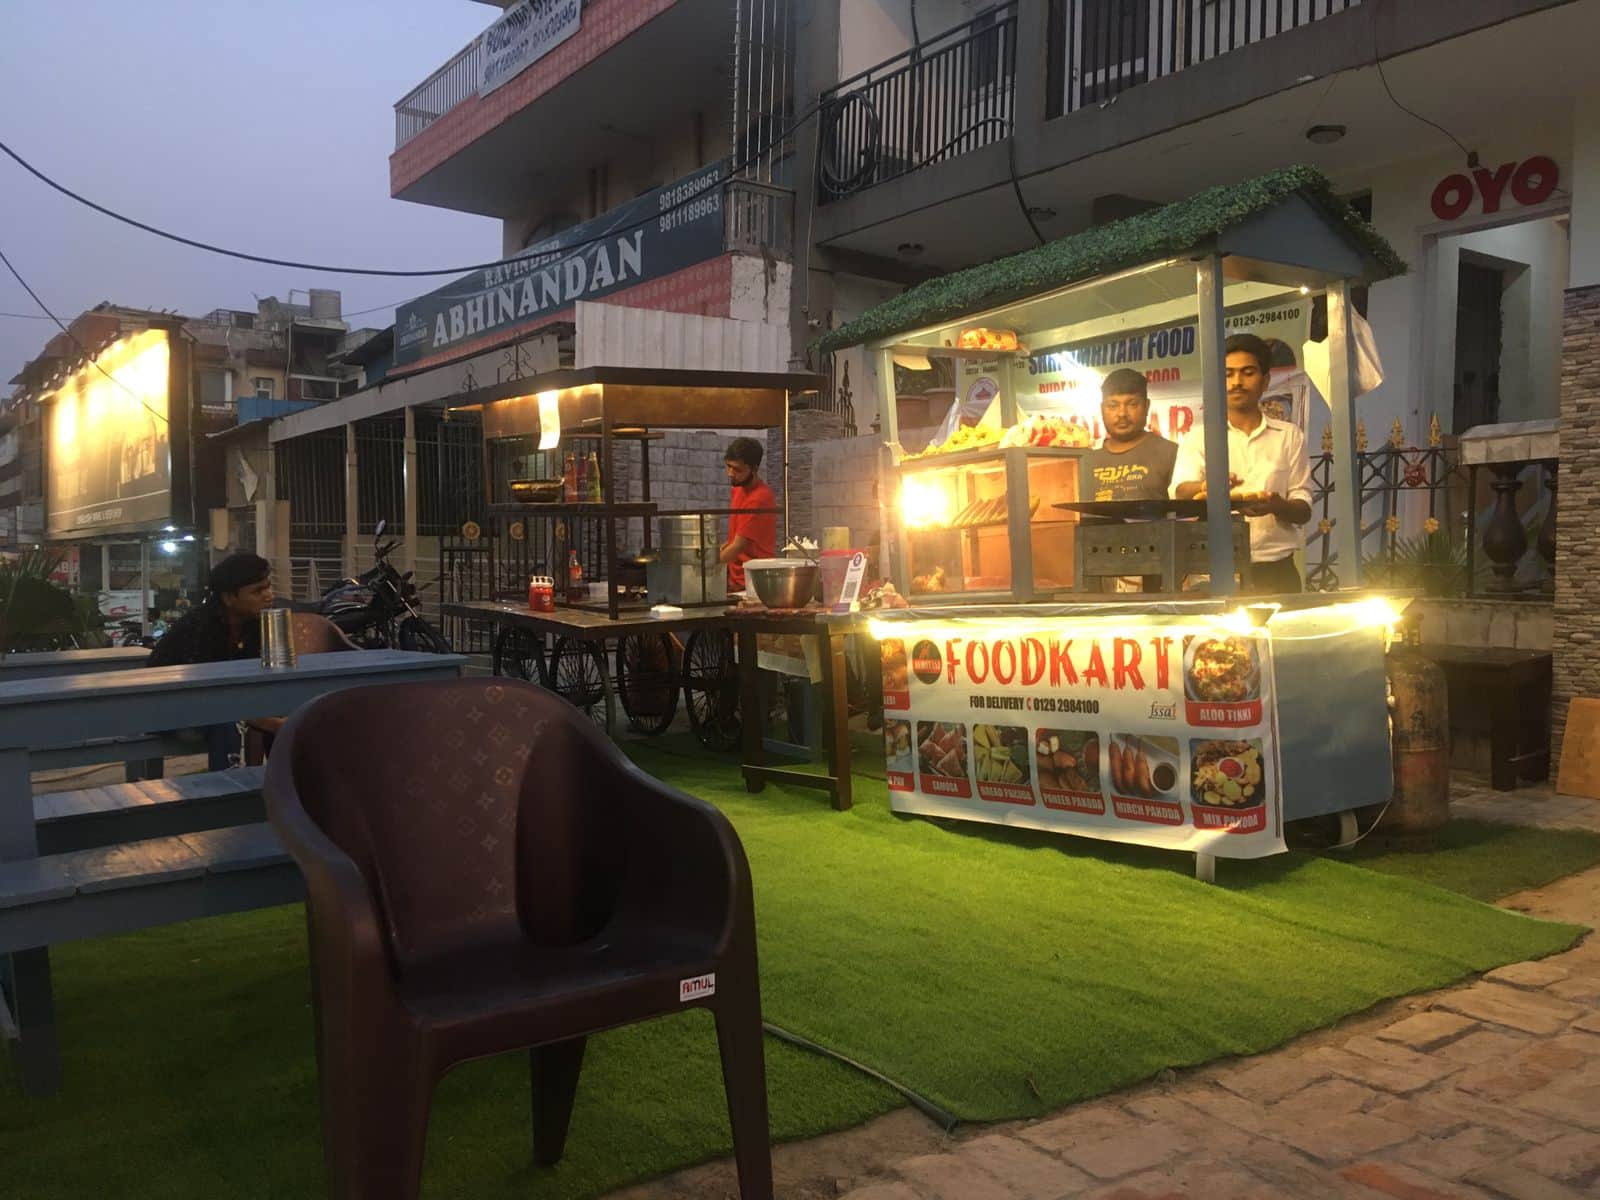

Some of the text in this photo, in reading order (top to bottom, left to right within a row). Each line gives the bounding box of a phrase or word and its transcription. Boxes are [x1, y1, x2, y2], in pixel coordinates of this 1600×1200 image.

[1430, 155, 1560, 221] OYO
[659, 193, 720, 233] 9811189963
[432, 229, 644, 347] ABHINANDAN
[1232, 307, 1300, 328] 0129-2984100
[1147, 325, 1196, 360] FOOD
[945, 635, 1174, 691] FOODKART
[969, 695, 1100, 715] FOR DELIVERY 0129 2984100
[1200, 708, 1252, 722] ALOO TIKKI
[1146, 807, 1181, 821] PAKODA
